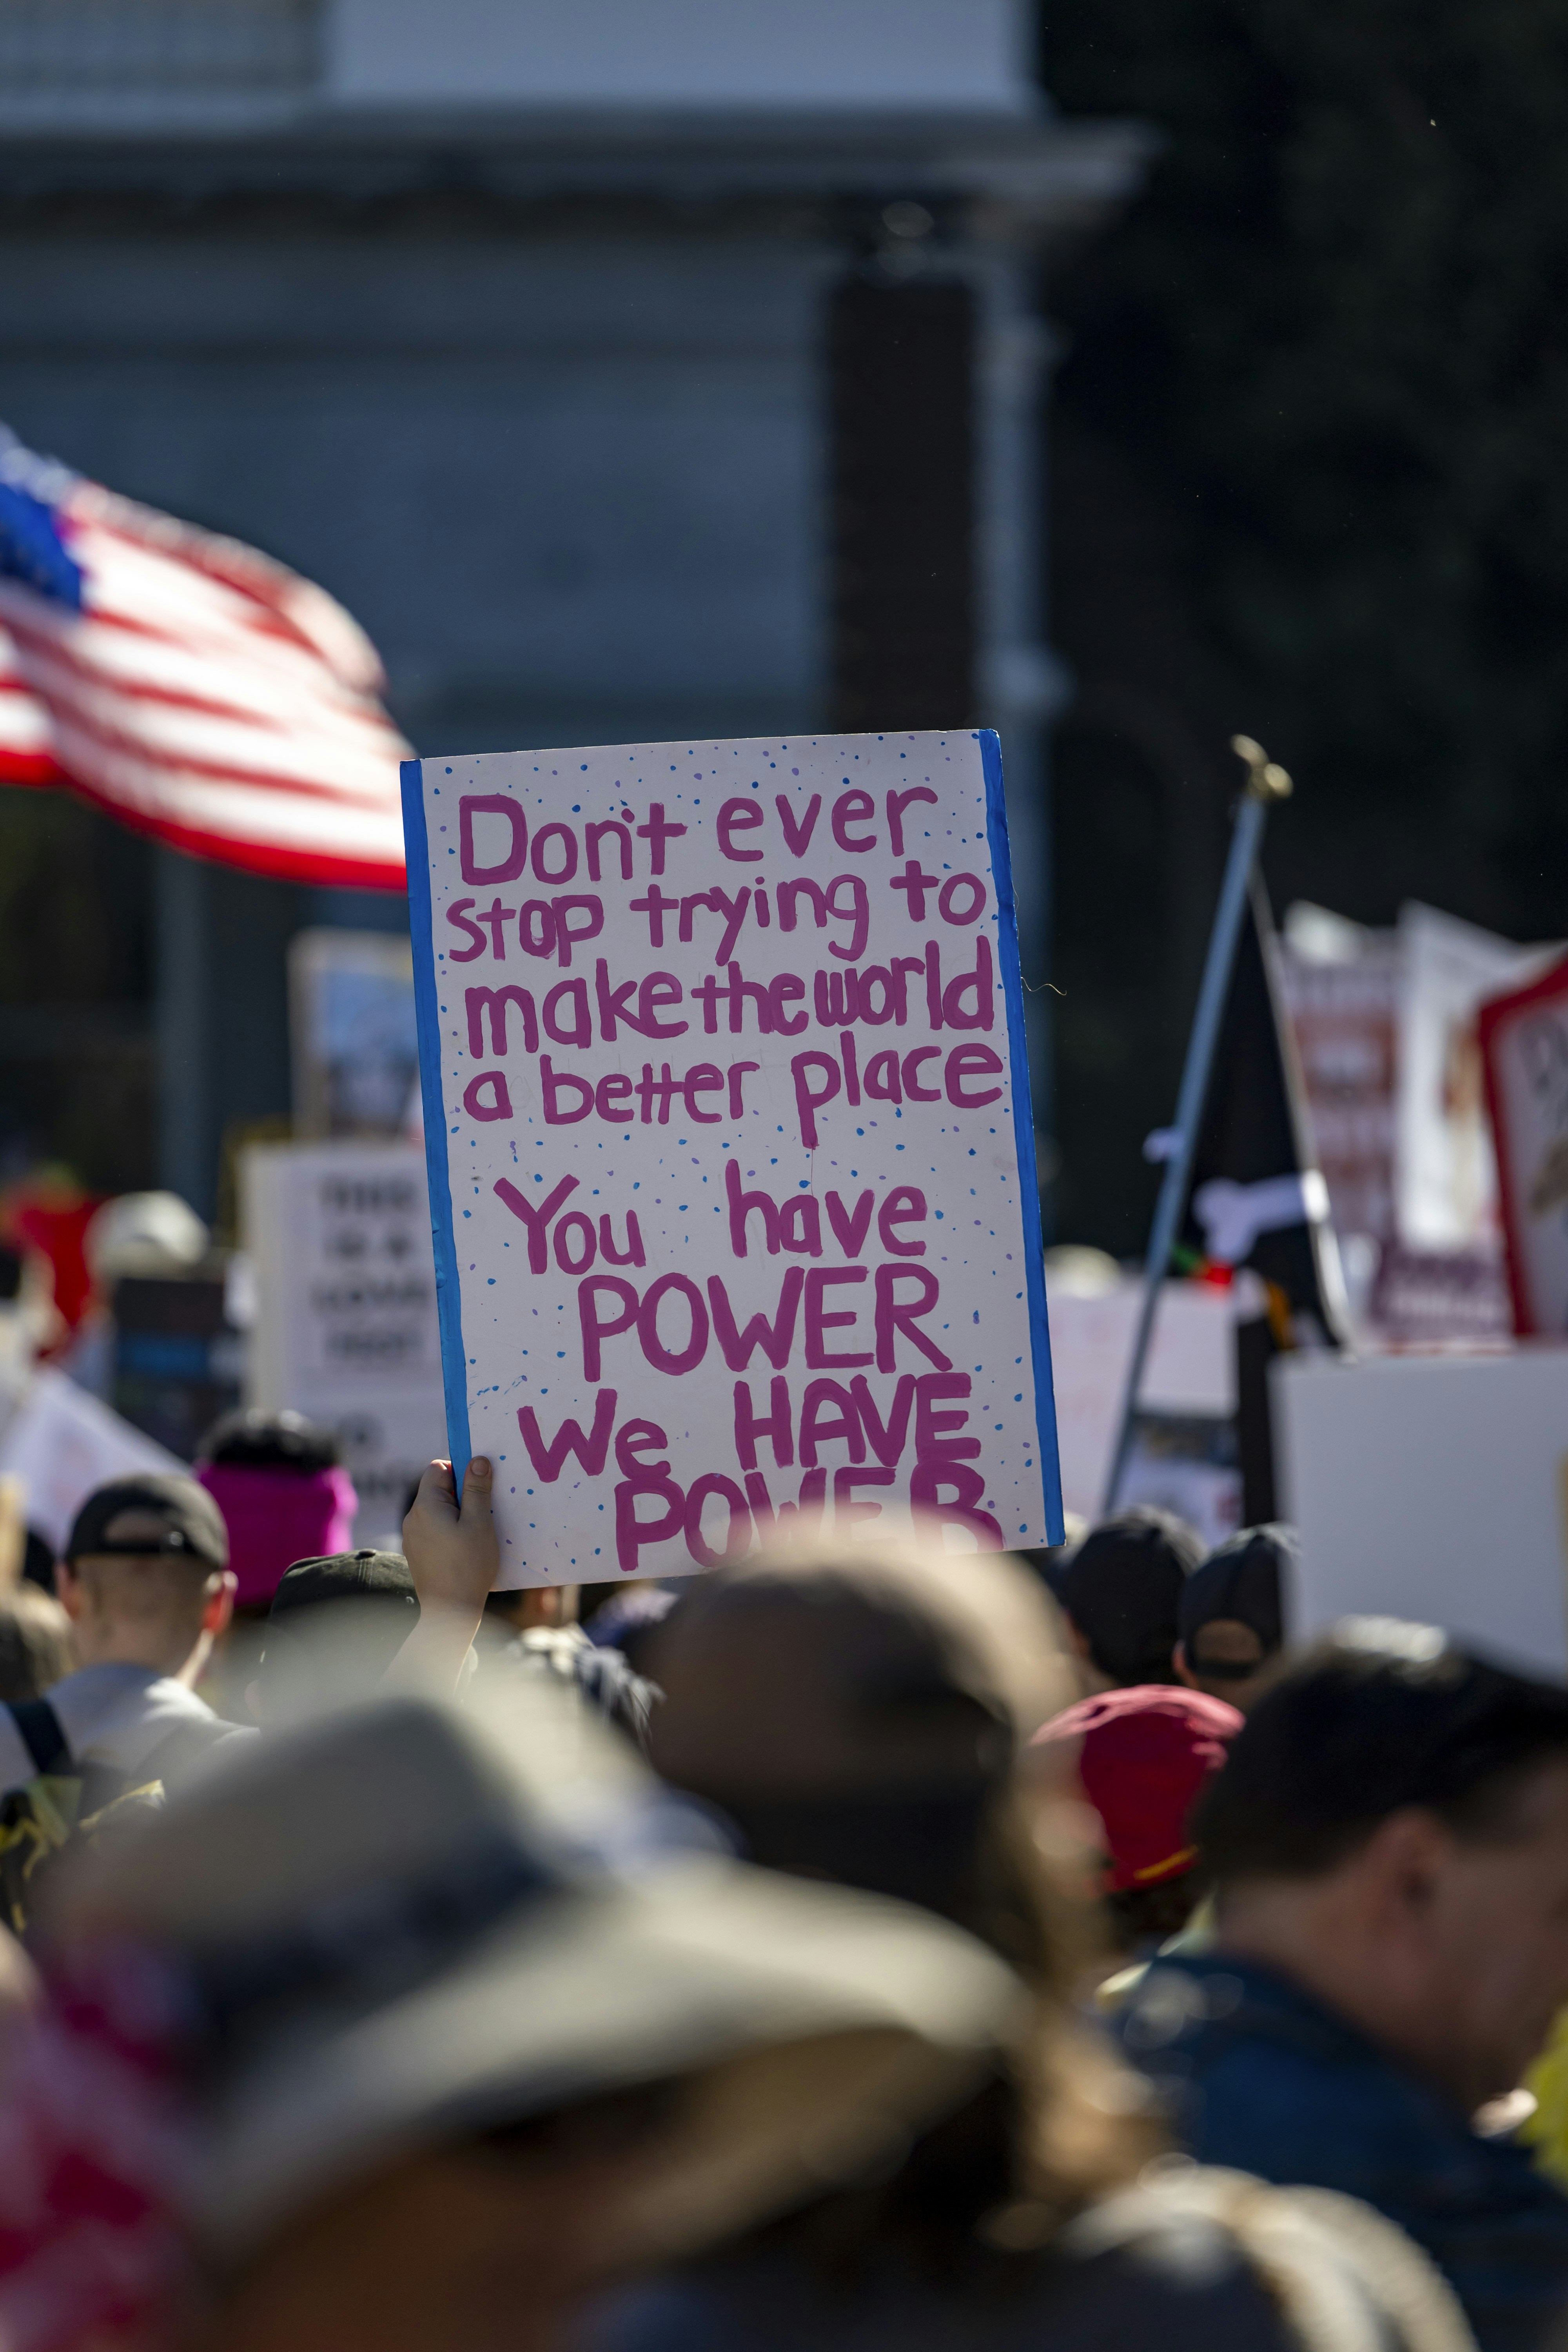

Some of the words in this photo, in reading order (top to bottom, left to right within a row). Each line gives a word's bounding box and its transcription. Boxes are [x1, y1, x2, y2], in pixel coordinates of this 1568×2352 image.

[459, 795, 687, 886] Don't
[717, 787, 938, 862] ever
[446, 895, 604, 967] stop
[630, 875, 869, 966] trying
[890, 860, 986, 925] to
[464, 1071, 513, 1122] a
[540, 1054, 759, 1125] better
[791, 1031, 1004, 1149] place
[494, 1174, 646, 1275] You
[726, 1159, 927, 1258] have
[579, 1263, 953, 1382] POWER
[517, 1389, 671, 1483] We
[734, 1372, 981, 1471] HAVE
